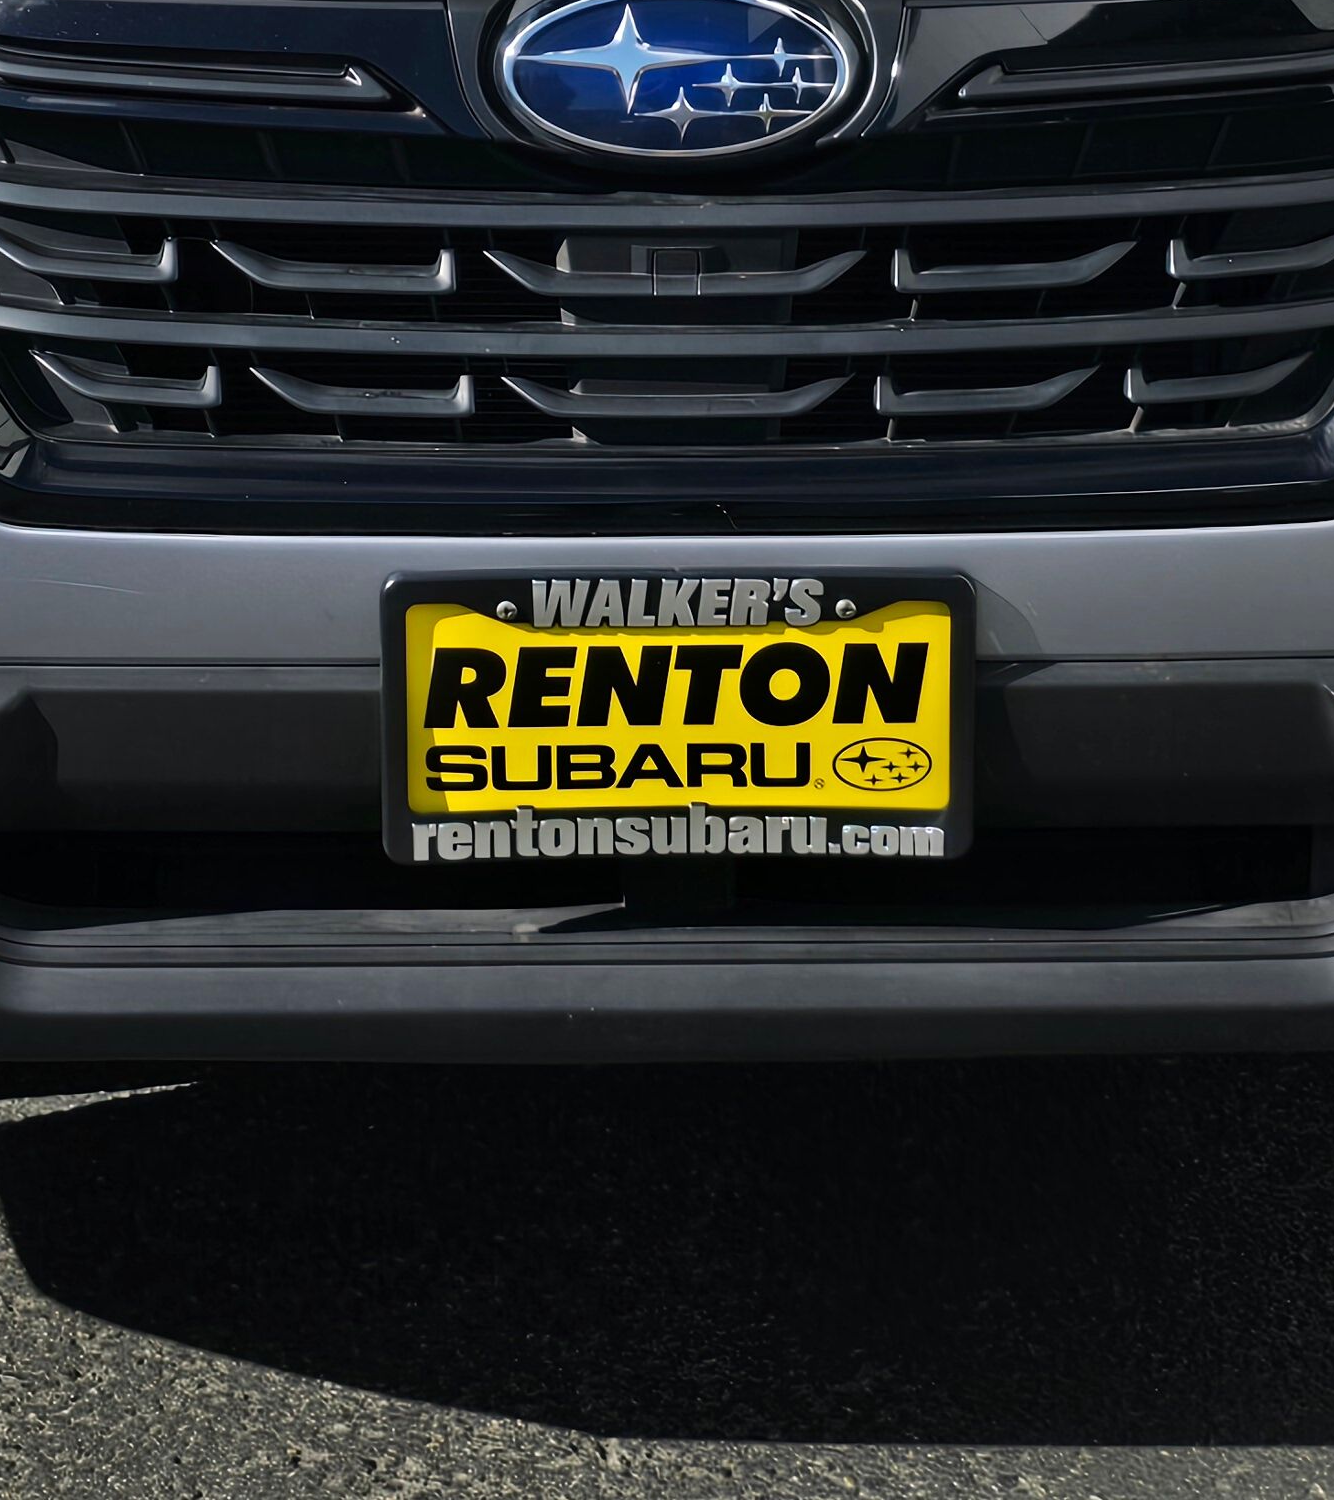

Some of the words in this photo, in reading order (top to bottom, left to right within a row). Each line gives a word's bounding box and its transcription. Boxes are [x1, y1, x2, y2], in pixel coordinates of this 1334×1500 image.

[532, 579, 824, 627] WALKER'S
[424, 642, 929, 728] RENTON
[424, 742, 811, 791] SUBARU
[412, 802, 945, 861] rentonsubaru.com
